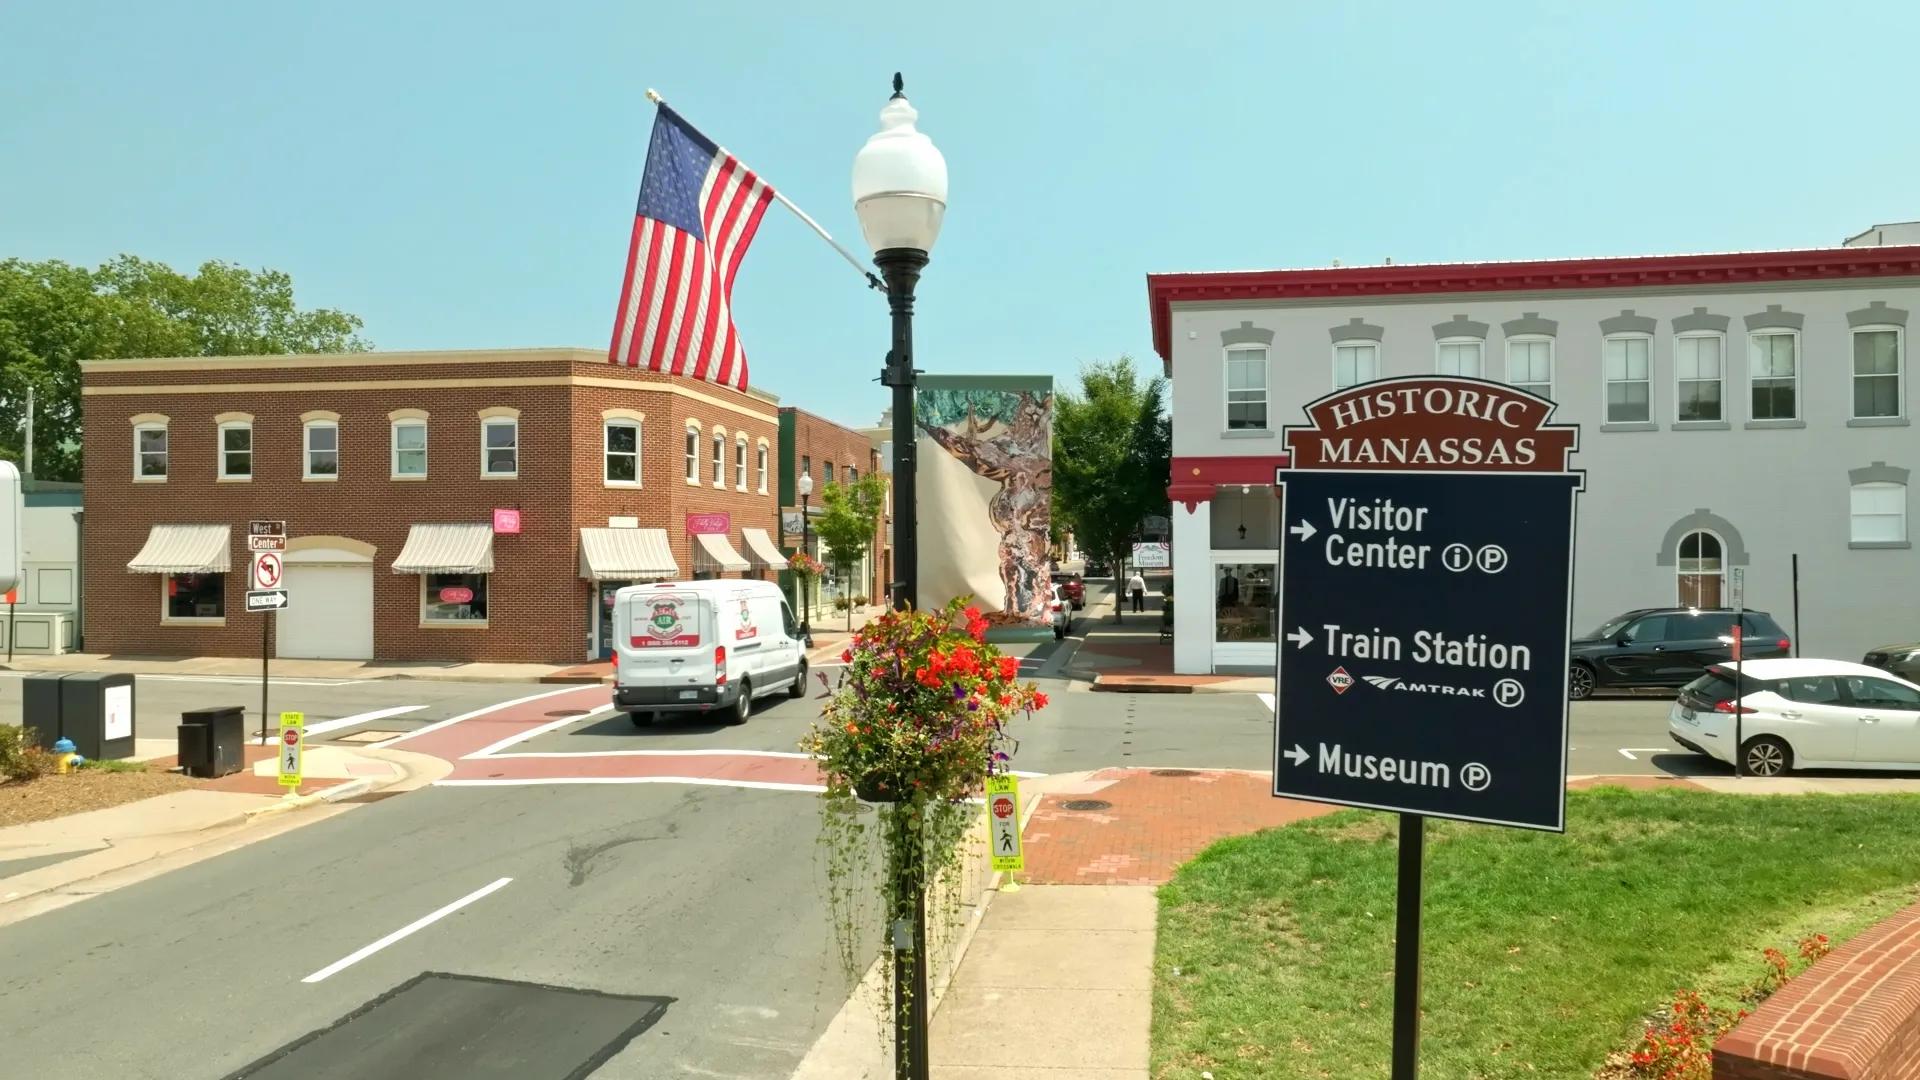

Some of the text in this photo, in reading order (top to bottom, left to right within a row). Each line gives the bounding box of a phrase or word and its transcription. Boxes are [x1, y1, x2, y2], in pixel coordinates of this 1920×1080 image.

[1329, 387, 1528, 430] HISTORIC
[1318, 437, 1537, 465] MANASSAS
[1327, 497, 1428, 532] Visitor
[252, 523, 272, 534] West
[253, 537, 278, 549] Center
[1325, 533, 1431, 570] Center
[251, 597, 262, 605] ONE
[656, 616, 673, 625] AIR
[1323, 623, 1531, 671] Train Station
[1332, 676, 1350, 685] VRE
[1394, 682, 1486, 698] AMTRAK
[1317, 742, 1450, 789] Museum
[994, 804, 1013, 813] STOP
